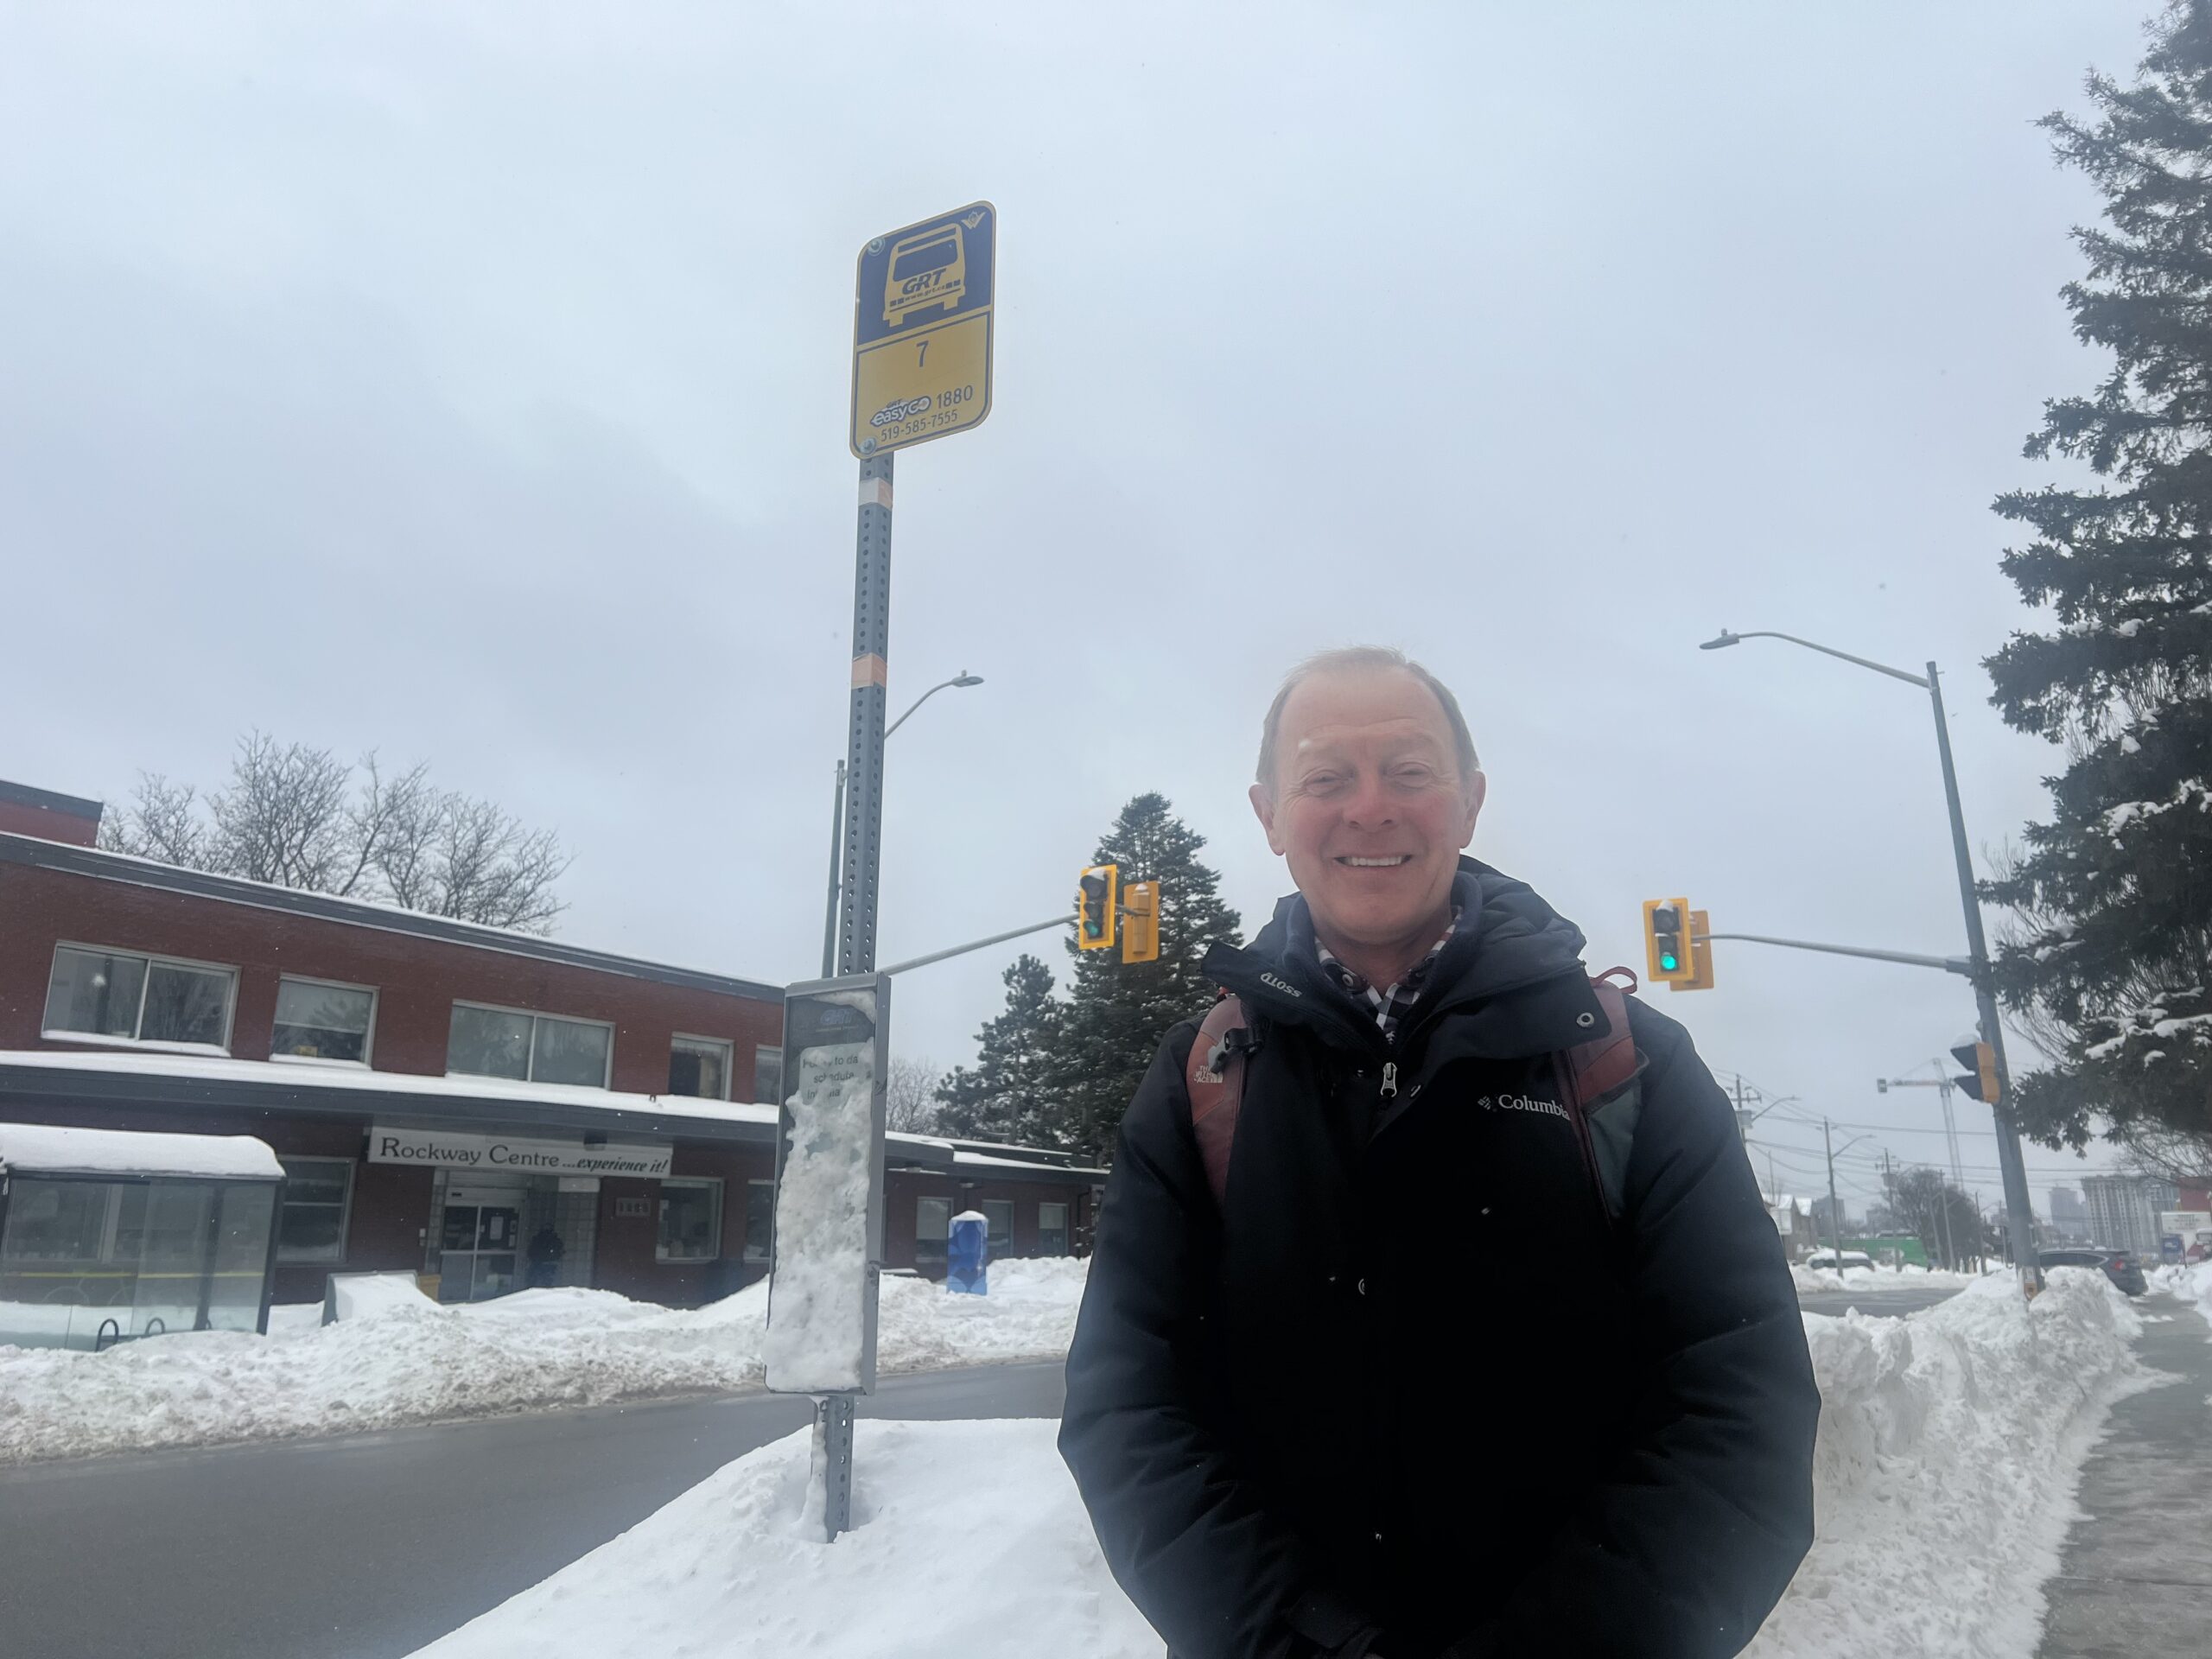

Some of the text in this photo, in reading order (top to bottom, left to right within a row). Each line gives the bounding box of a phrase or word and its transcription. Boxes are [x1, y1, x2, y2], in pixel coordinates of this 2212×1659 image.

[902, 268, 946, 295] GRT
[916, 340, 930, 367] 7
[937, 385, 973, 409] 1880
[881, 409, 957, 442] 519-585-7555
[380, 1136, 481, 1166] Rockway
[489, 1144, 559, 1167] Centre
[649, 1160, 669, 1173] it!
